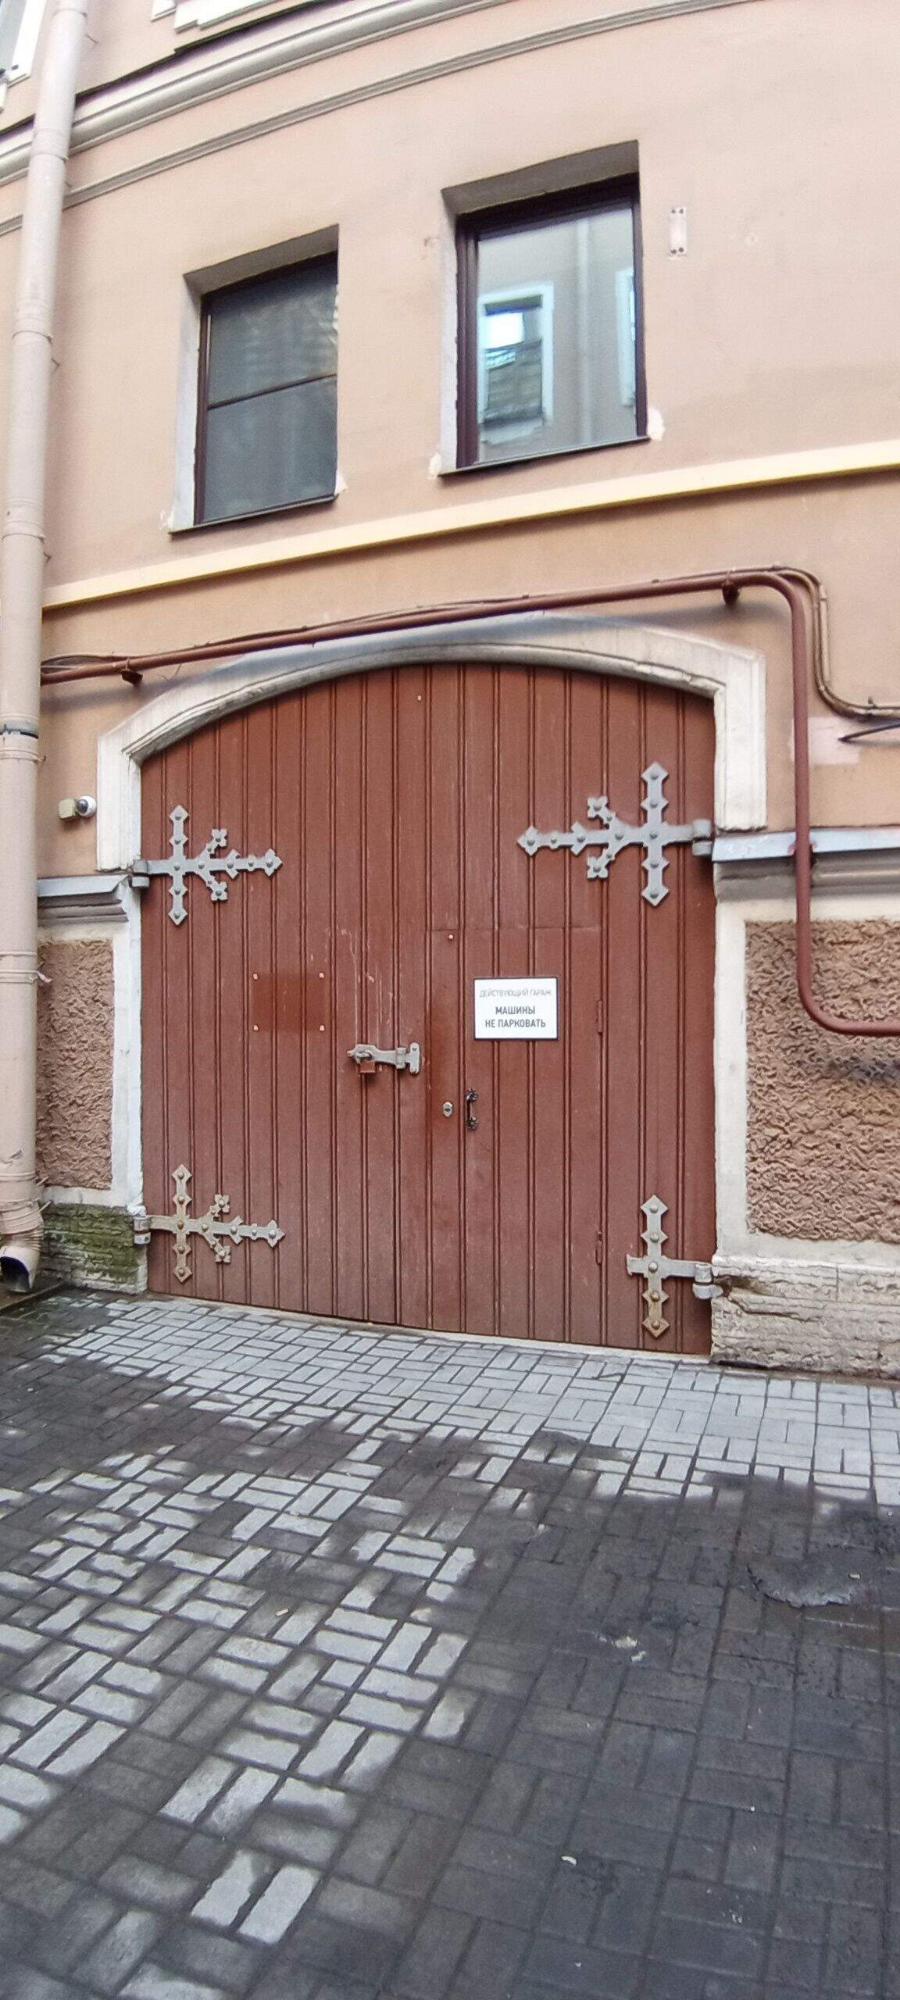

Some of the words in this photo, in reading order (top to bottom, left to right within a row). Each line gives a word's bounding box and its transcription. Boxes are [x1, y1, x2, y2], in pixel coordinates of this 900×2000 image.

[495, 1006, 536, 1015] МАШИНЫ
[485, 1019, 496, 1028] НЕ
[498, 1019, 546, 1028] ПАРКОВАТЬ
